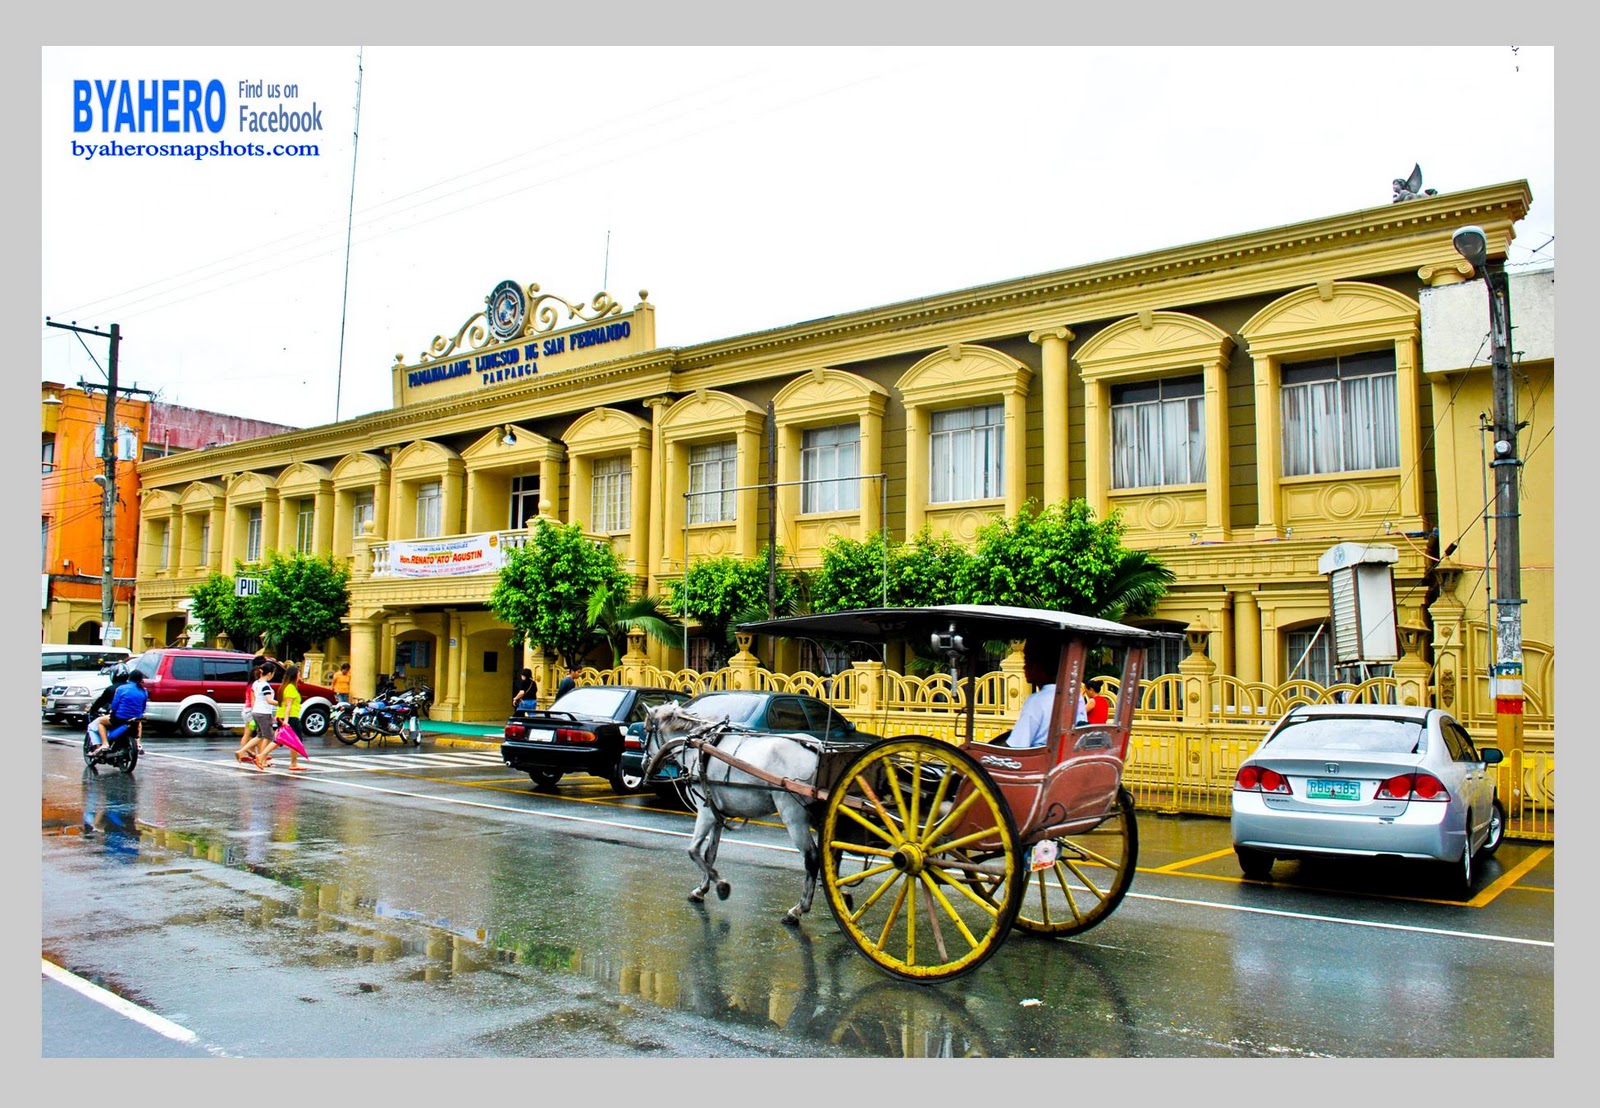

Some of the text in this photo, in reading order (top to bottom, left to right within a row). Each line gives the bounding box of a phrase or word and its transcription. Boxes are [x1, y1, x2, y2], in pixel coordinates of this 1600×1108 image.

[408, 321, 631, 388] PAMAHALAANG LUNGSOD NG SAN FERNANDO
[482, 362, 539, 385] PAMPANGA
[411, 555, 434, 564] RENATO
[452, 550, 482, 562] AGUSTIN
[1335, 783, 1357, 795] 385
